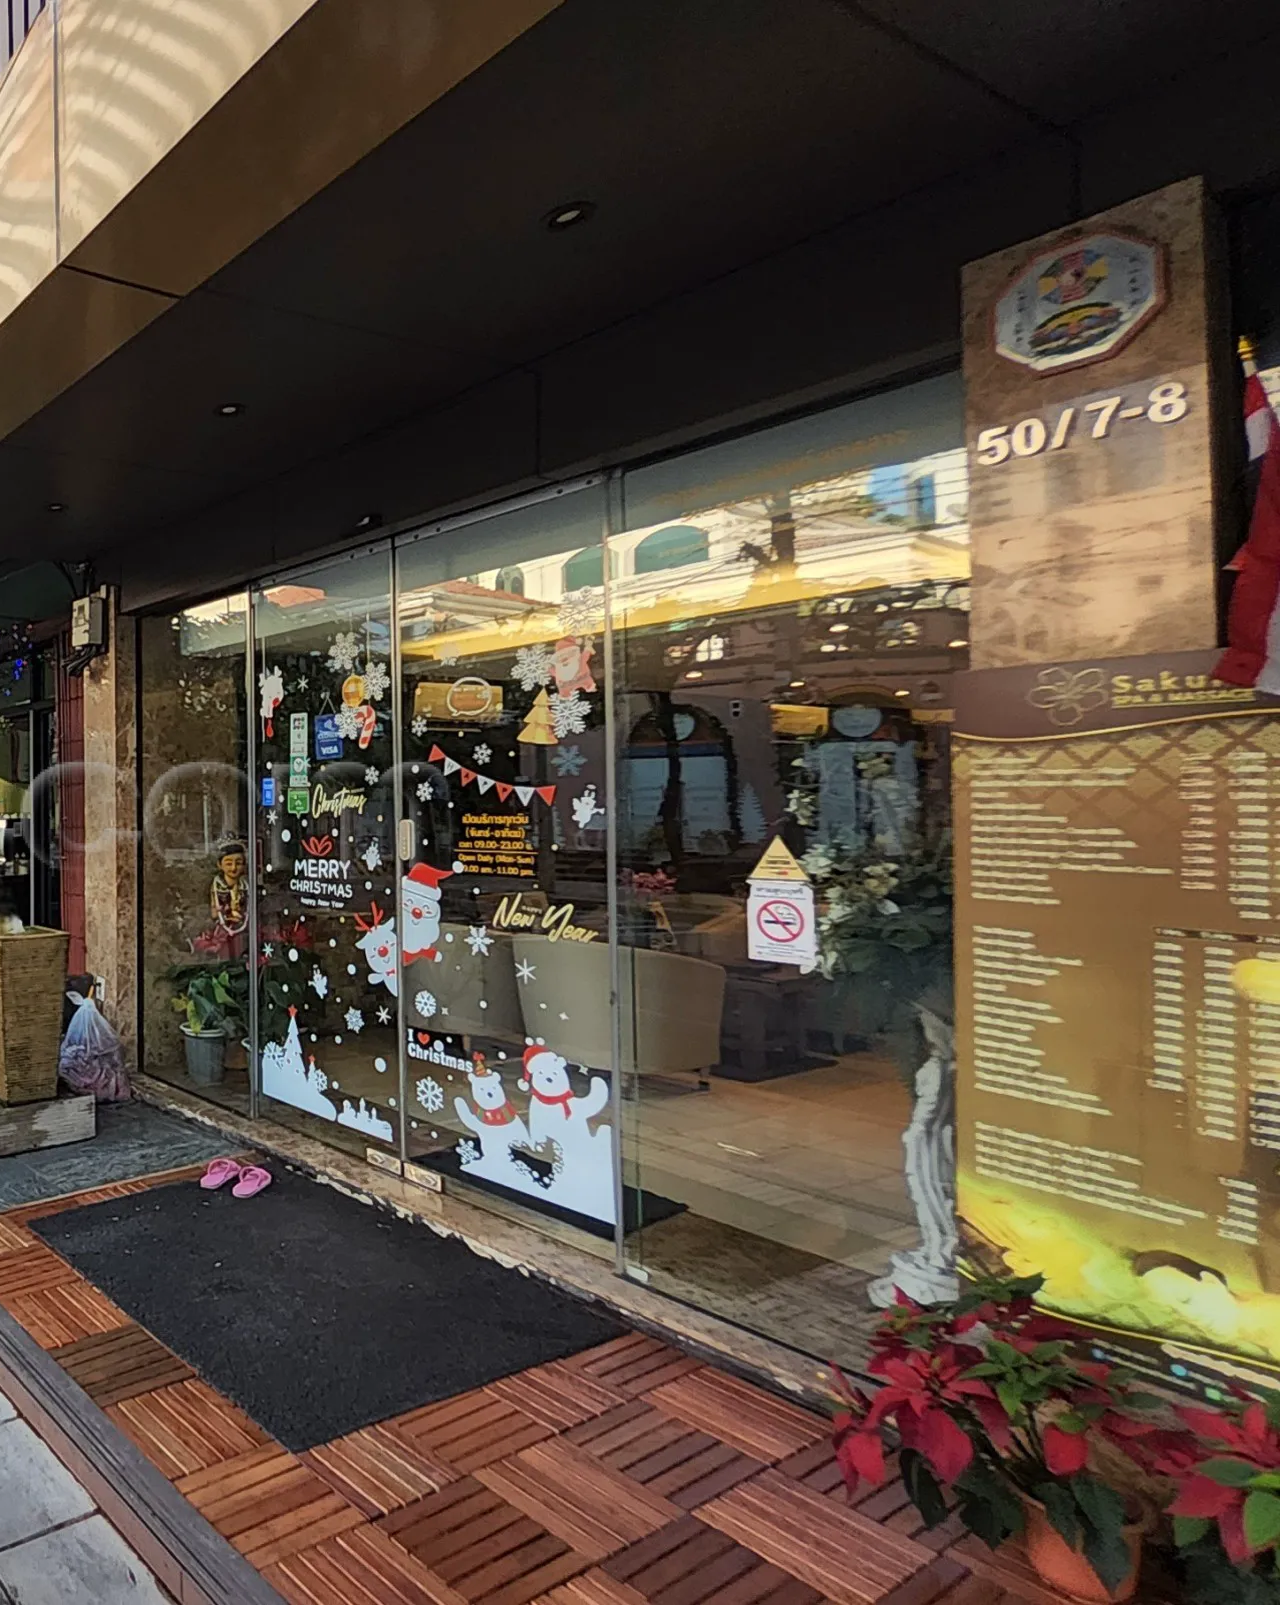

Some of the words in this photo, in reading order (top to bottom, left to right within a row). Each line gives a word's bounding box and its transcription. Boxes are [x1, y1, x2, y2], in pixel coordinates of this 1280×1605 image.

[976, 382, 1189, 466] 50/7-8
[320, 745, 339, 755] VISA
[312, 783, 367, 819] Christmas
[294, 858, 351, 880] MERRY
[458, 853, 476, 862] Open
[477, 854, 494, 864] Daily
[289, 879, 353, 899] CHRISTMAS
[492, 892, 536, 928] New
[541, 903, 599, 943] Year
[407, 1028, 414, 1042] I
[407, 1042, 473, 1073] Christmas
